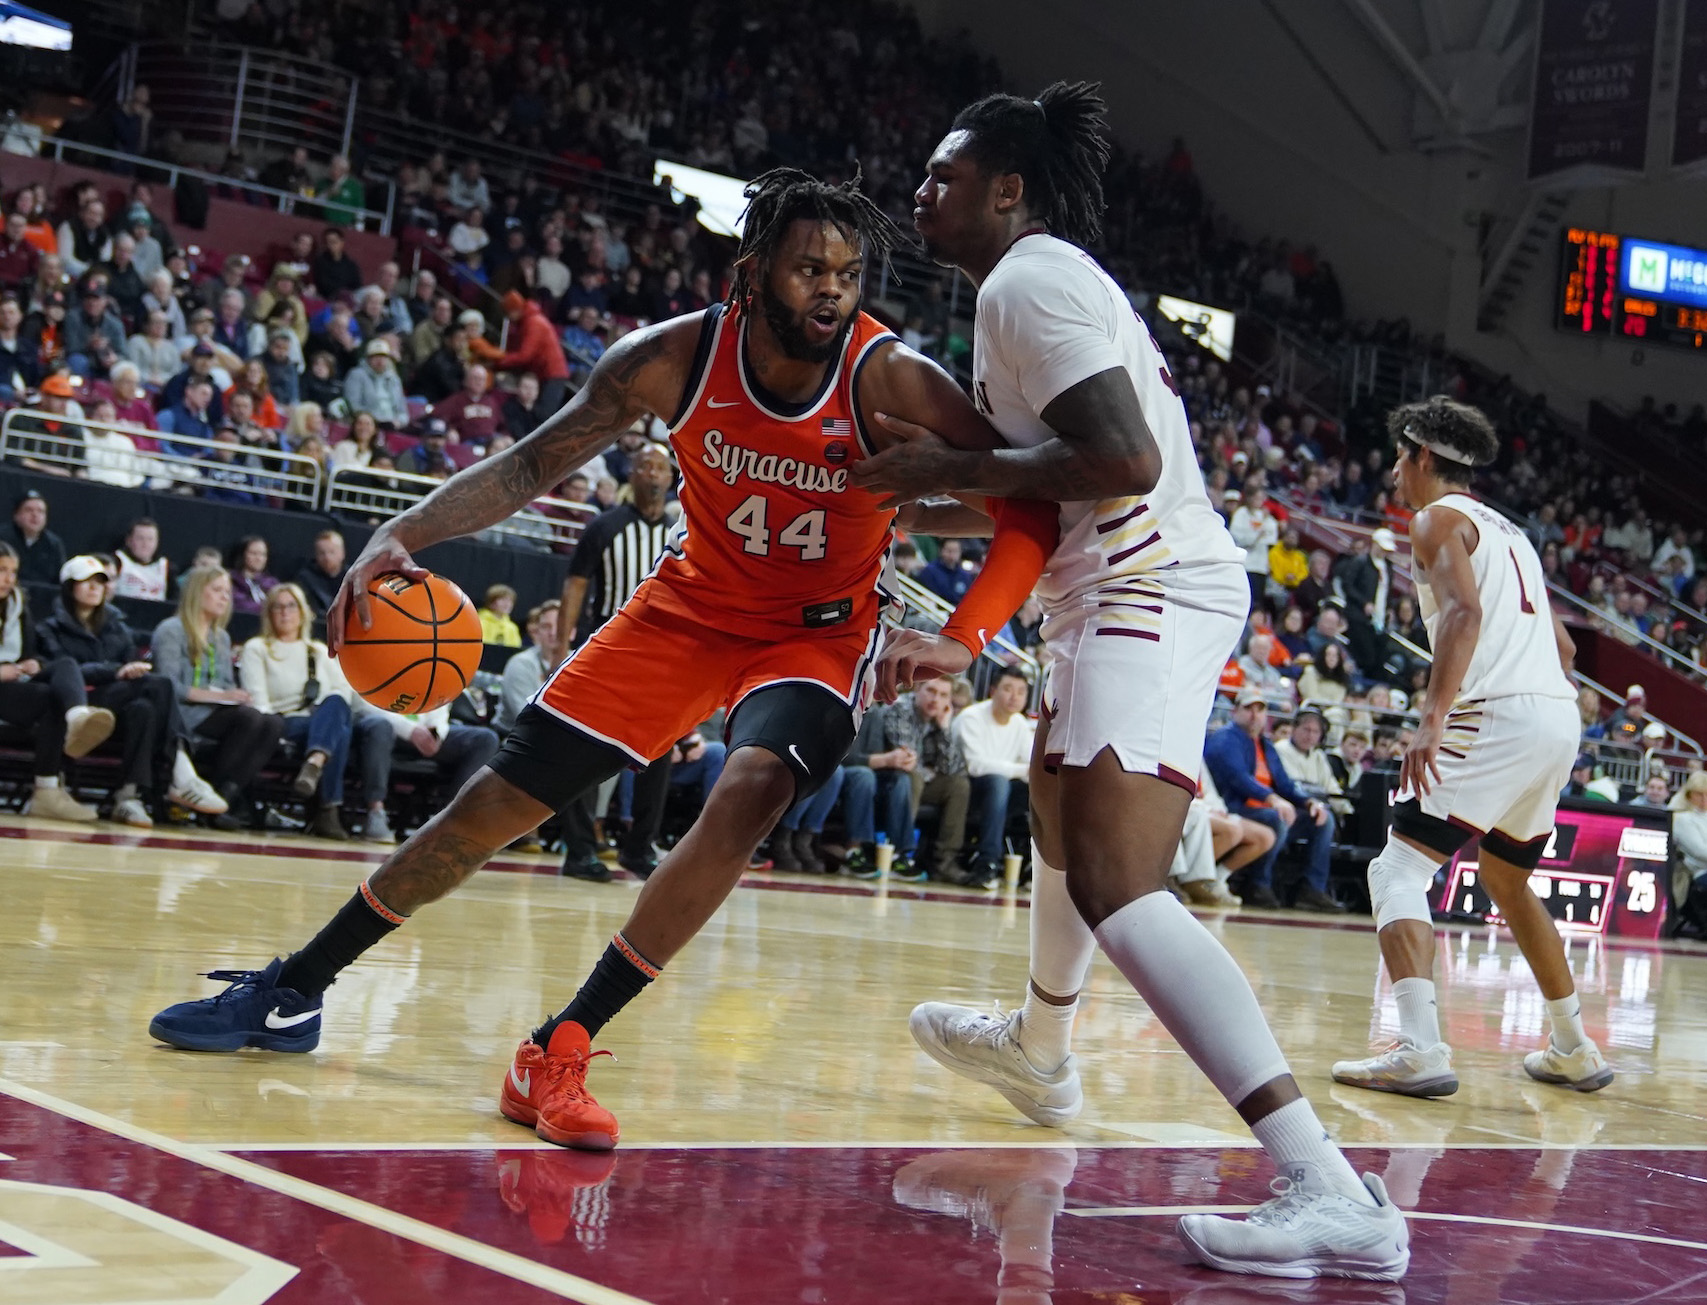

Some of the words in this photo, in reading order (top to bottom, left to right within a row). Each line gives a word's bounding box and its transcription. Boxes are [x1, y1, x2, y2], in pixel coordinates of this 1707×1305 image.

[1638, 256, 1659, 286] M
[701, 429, 849, 494] Syracuse
[726, 494, 827, 561] 44
[1503, 545, 1536, 615] 1
[1627, 870, 1656, 913] 25
